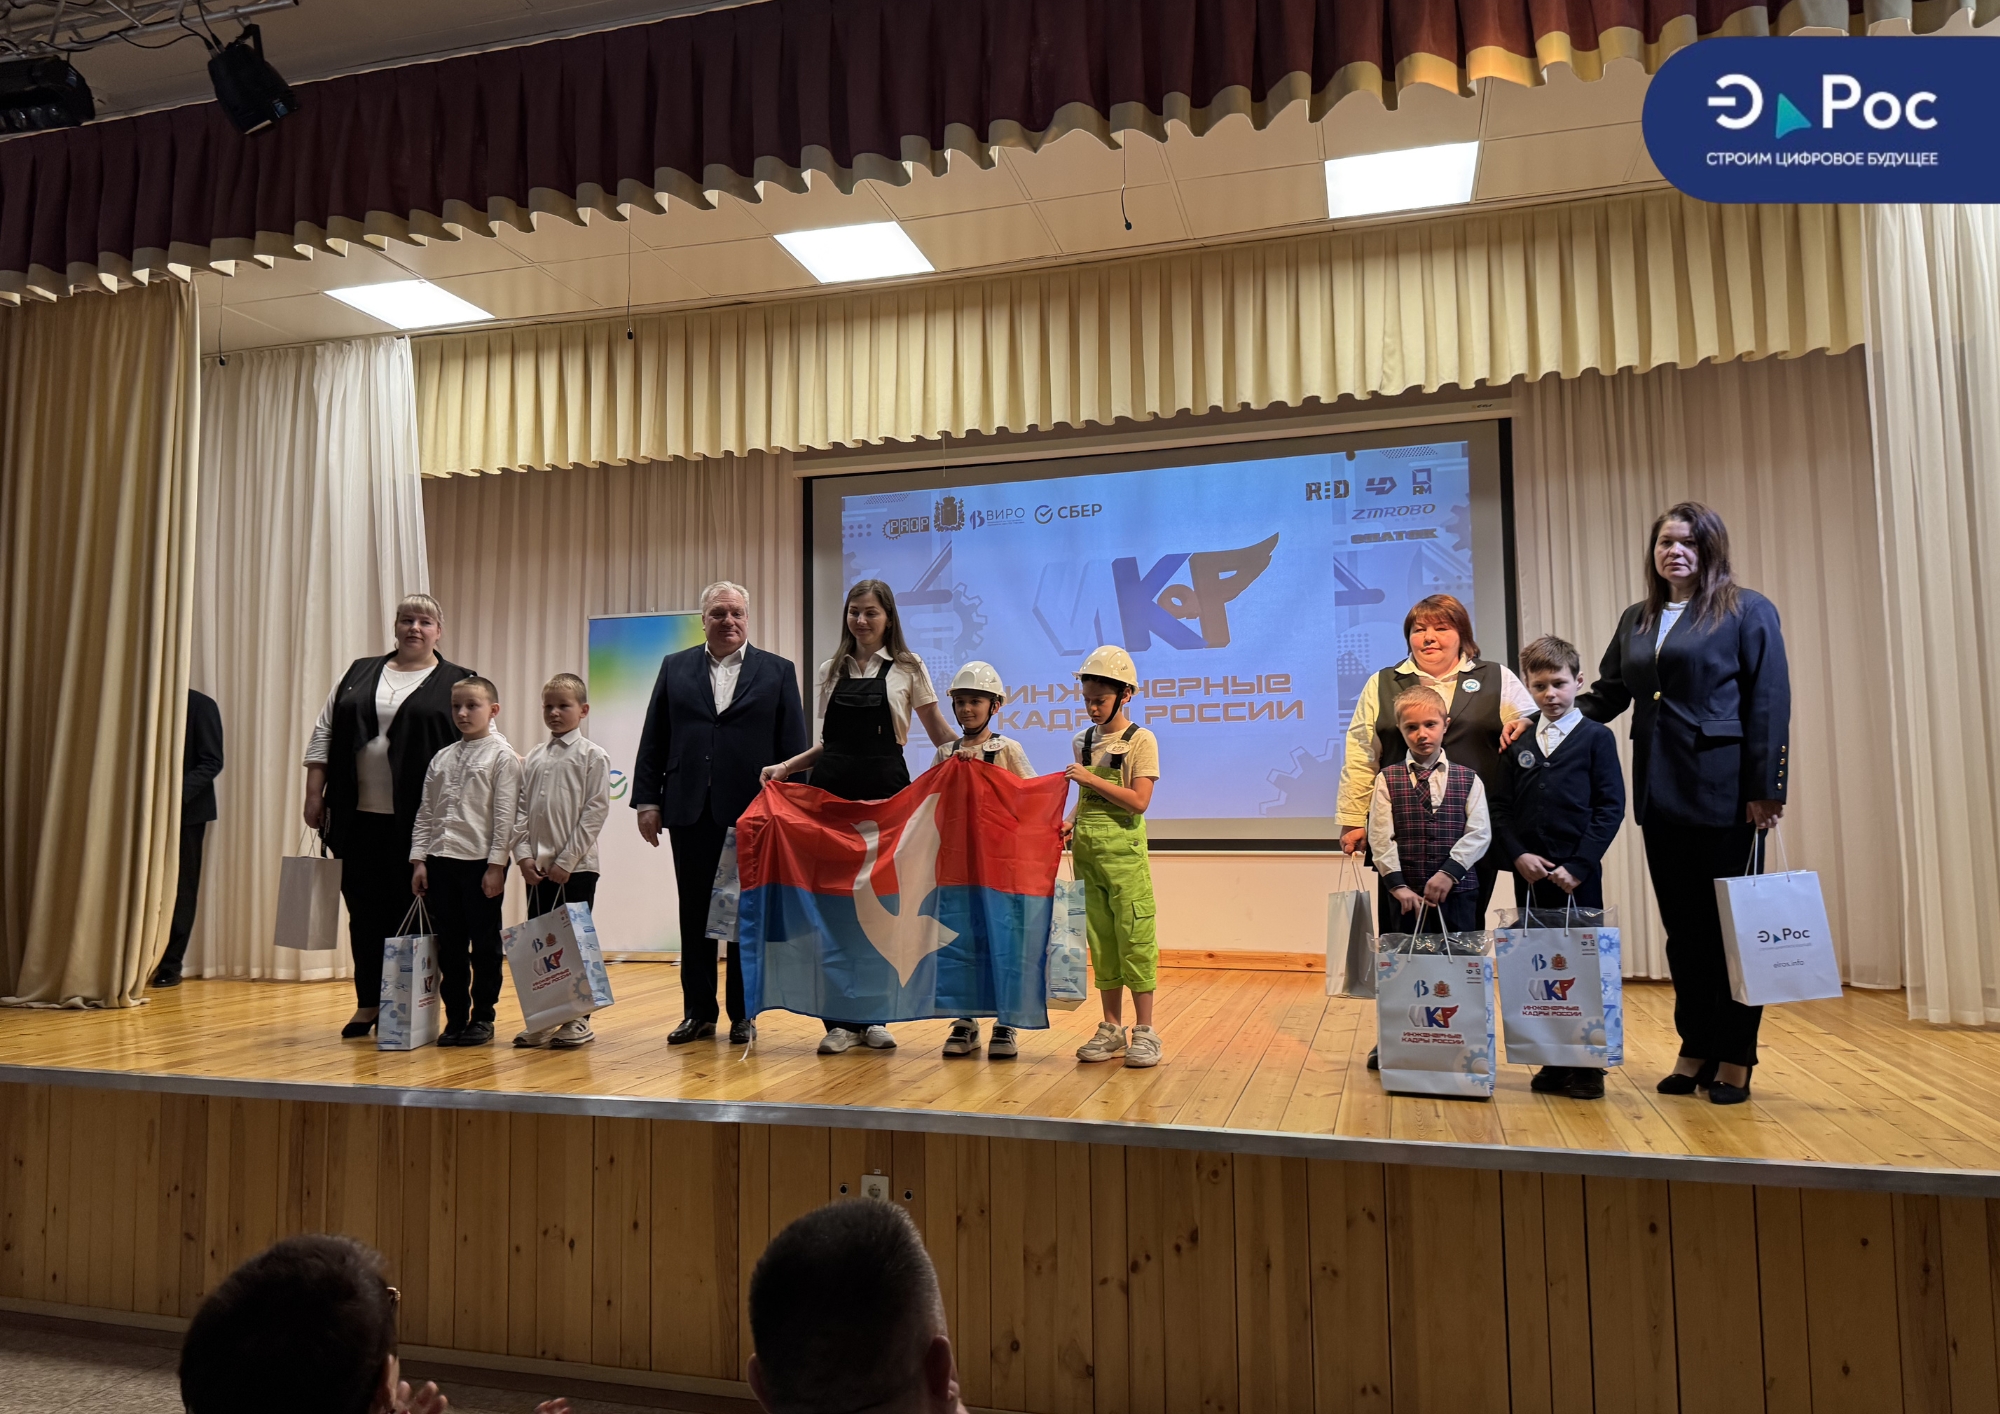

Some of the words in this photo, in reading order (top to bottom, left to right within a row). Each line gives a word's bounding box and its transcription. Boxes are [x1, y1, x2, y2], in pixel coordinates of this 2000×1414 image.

[987, 507, 1025, 521] ВИРО
[1057, 503, 1103, 519] СБЕР
[1351, 503, 1436, 520] ZMROBO
[1003, 673, 1292, 705] ИНЖЕРНЫЕ
[1144, 700, 1304, 725] РОССИИ
